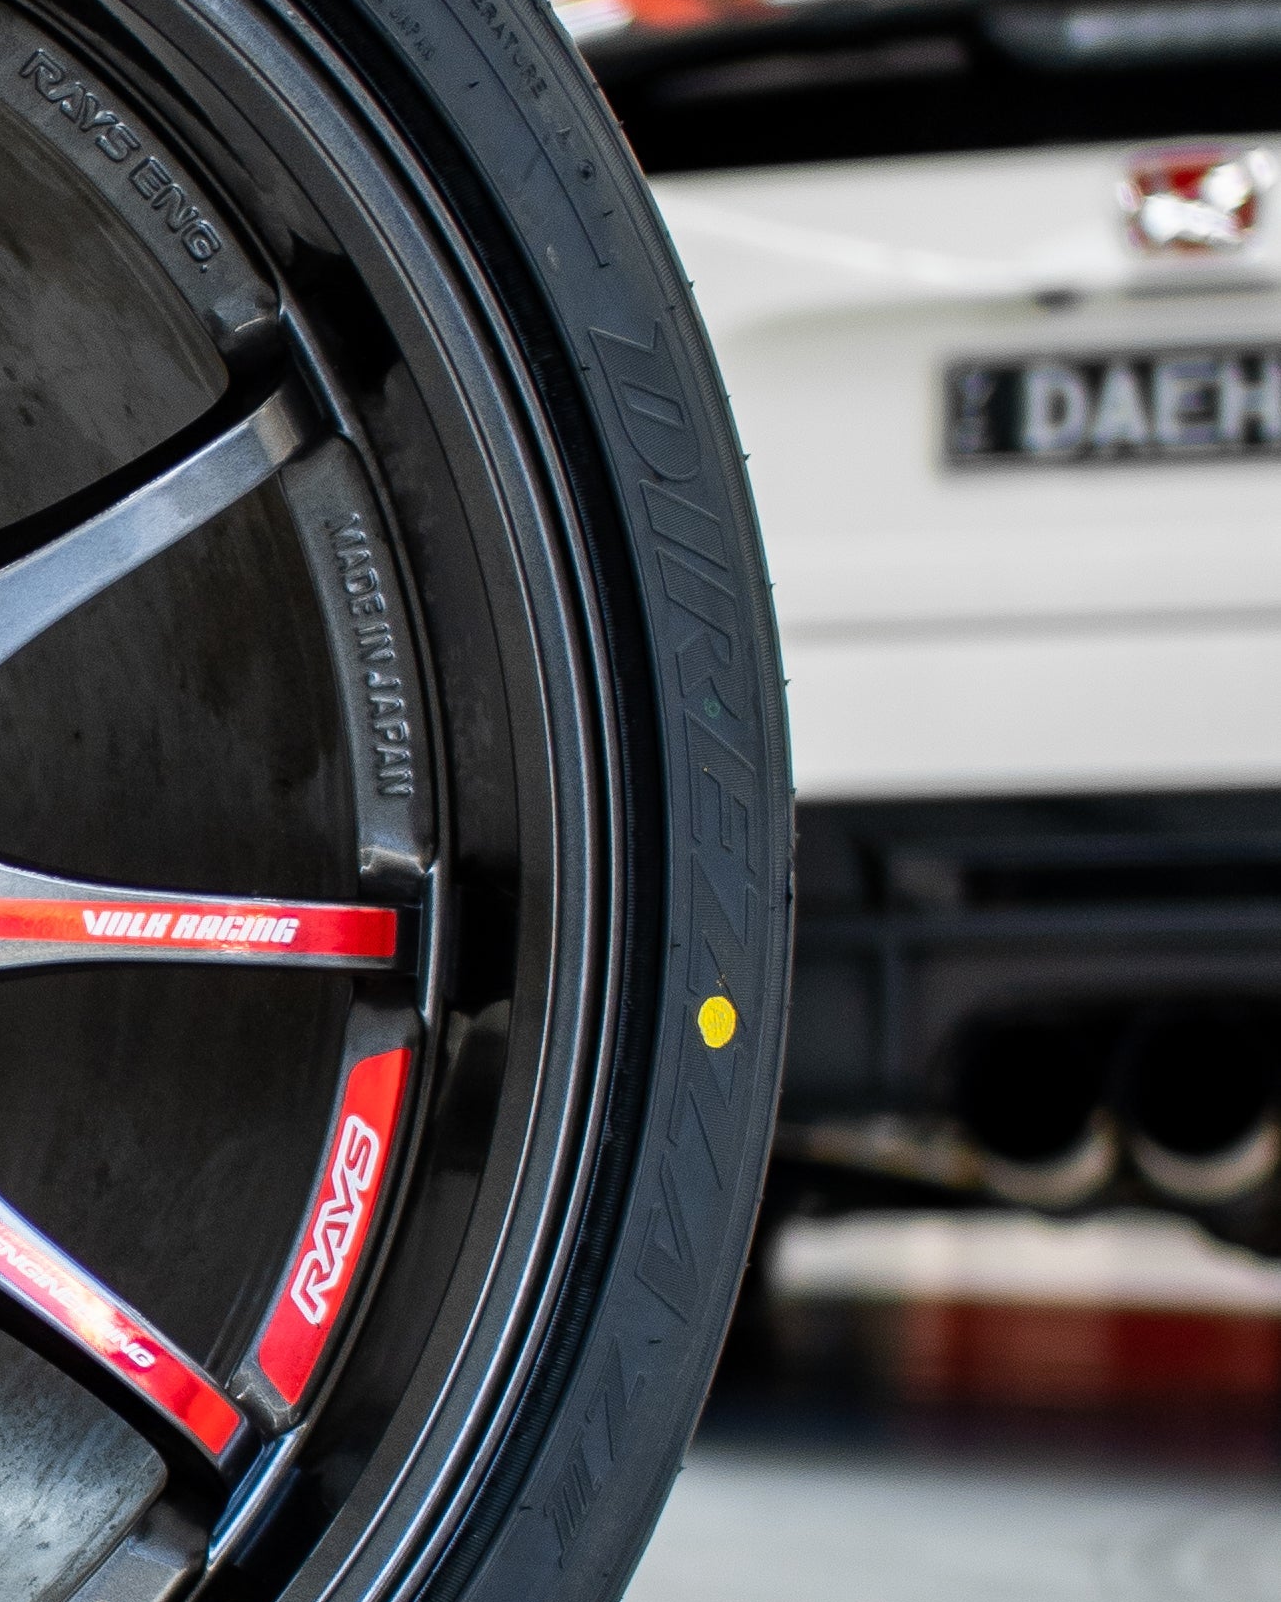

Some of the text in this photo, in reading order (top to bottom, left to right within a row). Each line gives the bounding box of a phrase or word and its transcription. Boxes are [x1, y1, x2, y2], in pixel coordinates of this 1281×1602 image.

[17, 48, 138, 163] RAYS
[325, 512, 415, 798] MADE IN JAPAN
[82, 910, 300, 944] VOLK RACING
[588, 319, 760, 1326] DIREZZA
[290, 1115, 379, 1324] RAYS
